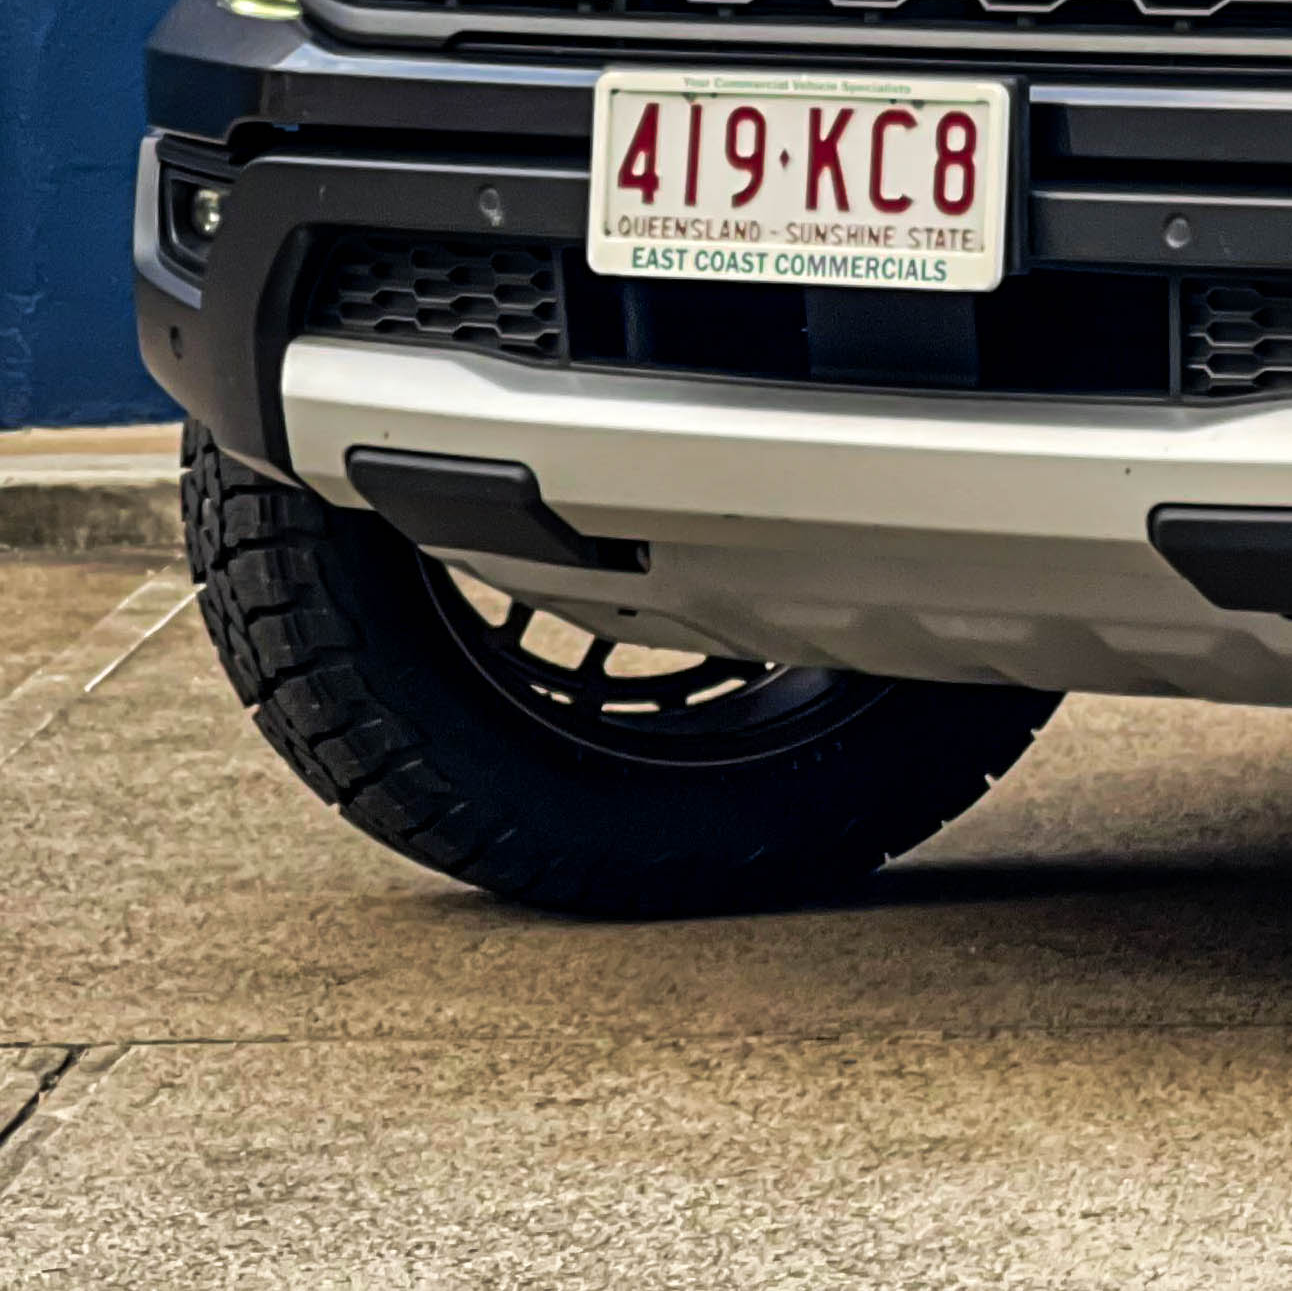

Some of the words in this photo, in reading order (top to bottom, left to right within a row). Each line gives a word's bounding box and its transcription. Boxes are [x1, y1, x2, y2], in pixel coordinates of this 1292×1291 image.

[617, 215, 761, 243] QUEENSLAND
[785, 222, 896, 247] SUNSHINE
[907, 226, 975, 250] STATE
[632, 246, 686, 270] EAST
[694, 249, 766, 275] COAST
[774, 252, 948, 282] COMMERCIALS
